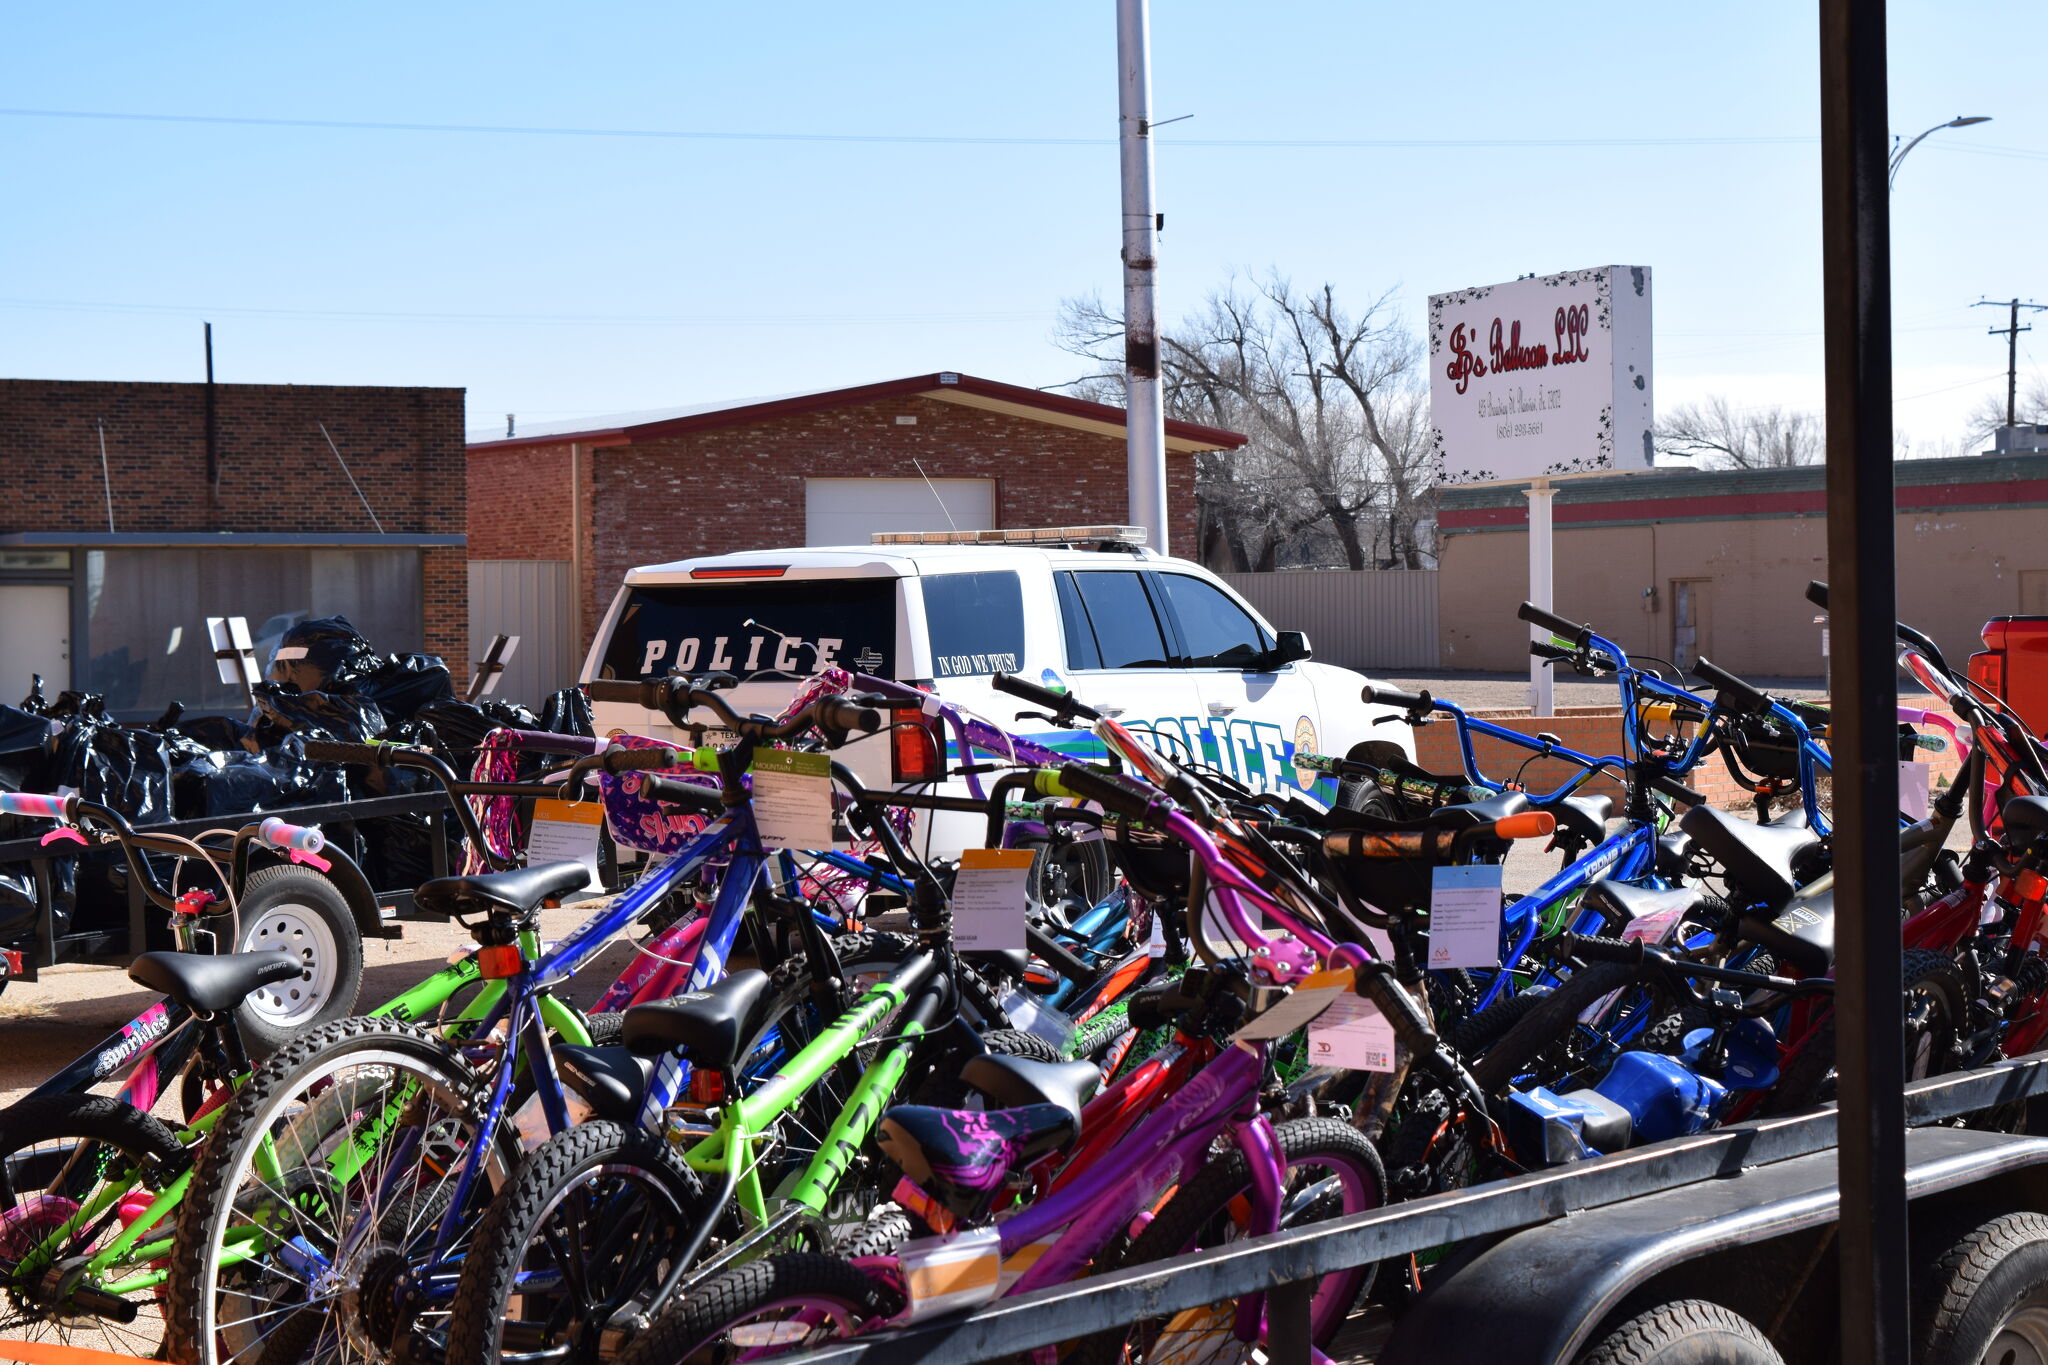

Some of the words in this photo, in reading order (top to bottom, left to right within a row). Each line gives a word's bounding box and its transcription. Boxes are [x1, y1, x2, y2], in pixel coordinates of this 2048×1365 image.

[1490, 317, 1549, 374] Ballroom
[1552, 303, 1589, 365] LLC
[640, 636, 843, 674] POLICE
[938, 657, 949, 675] IN
[950, 655, 972, 674] GOD
[971, 654, 989, 673] WE
[988, 652, 1018, 673] TRUST
[720, 731, 739, 739] TEXA
[755, 762, 791, 772] MOUNTAIN
[1079, 1014, 1130, 1056] INVADER
